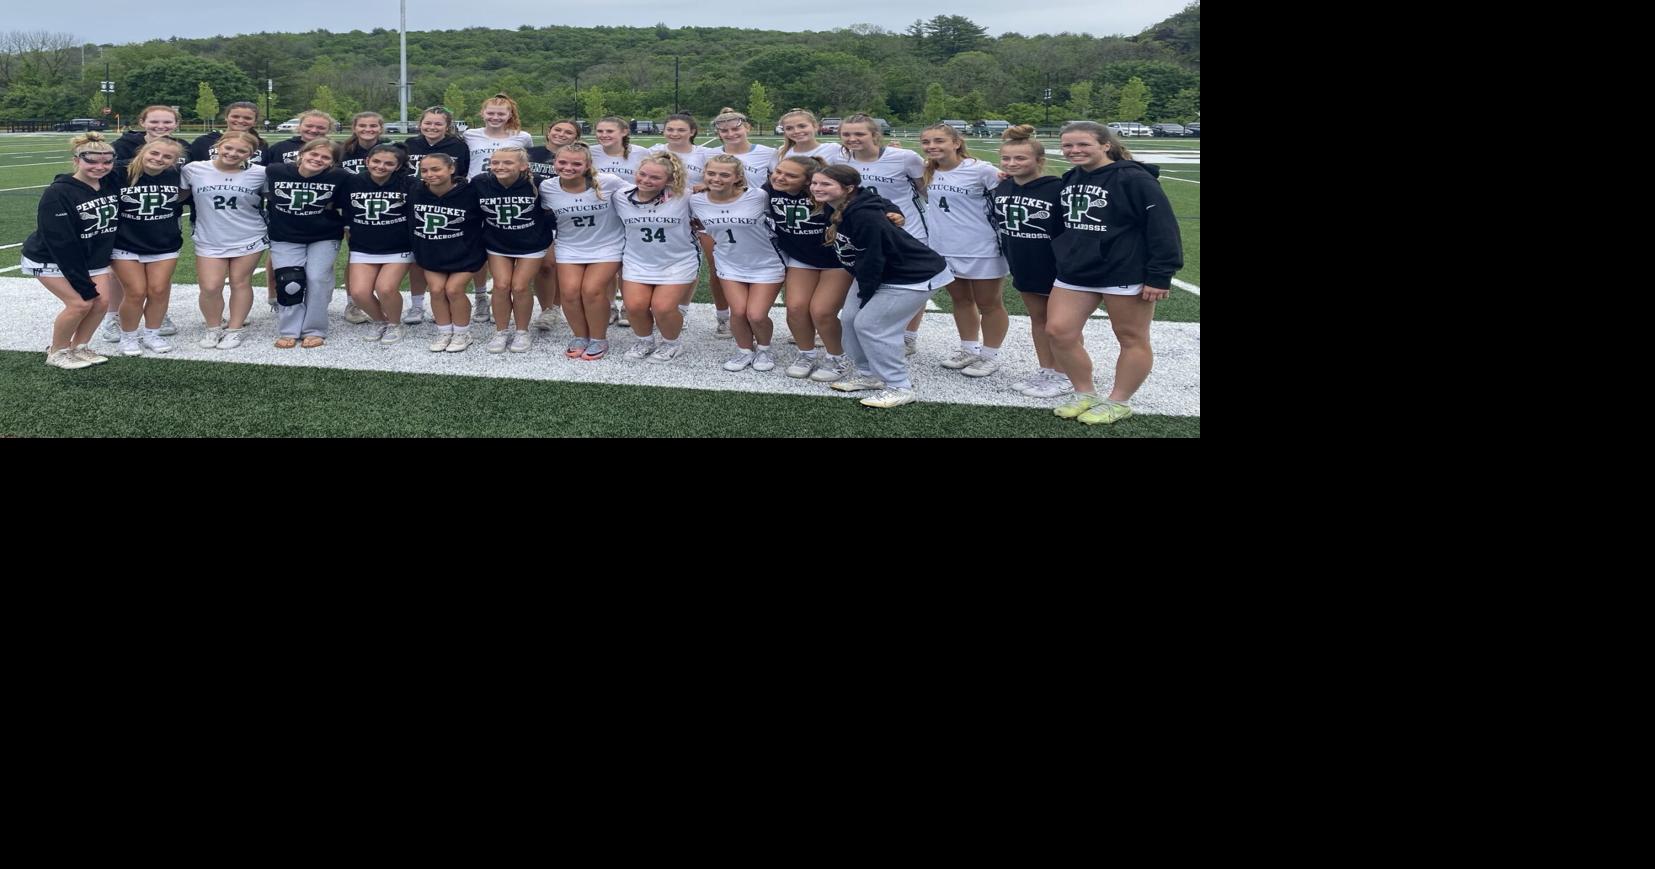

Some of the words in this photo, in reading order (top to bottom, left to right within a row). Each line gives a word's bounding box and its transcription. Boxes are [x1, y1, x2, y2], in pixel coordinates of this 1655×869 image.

[274, 181, 336, 191] PENTUCKET
[213, 195, 238, 210] 24
[350, 191, 408, 201] PENTUCKET
[479, 196, 536, 205] PENTUCKET
[413, 204, 467, 217] PENTUCKET
[939, 196, 950, 212] 4
[571, 214, 596, 228] 27
[624, 216, 681, 224] PENTUCKET
[702, 216, 758, 225] ENTUCKET
[640, 227, 666, 243] 34
[725, 228, 737, 244] 1
